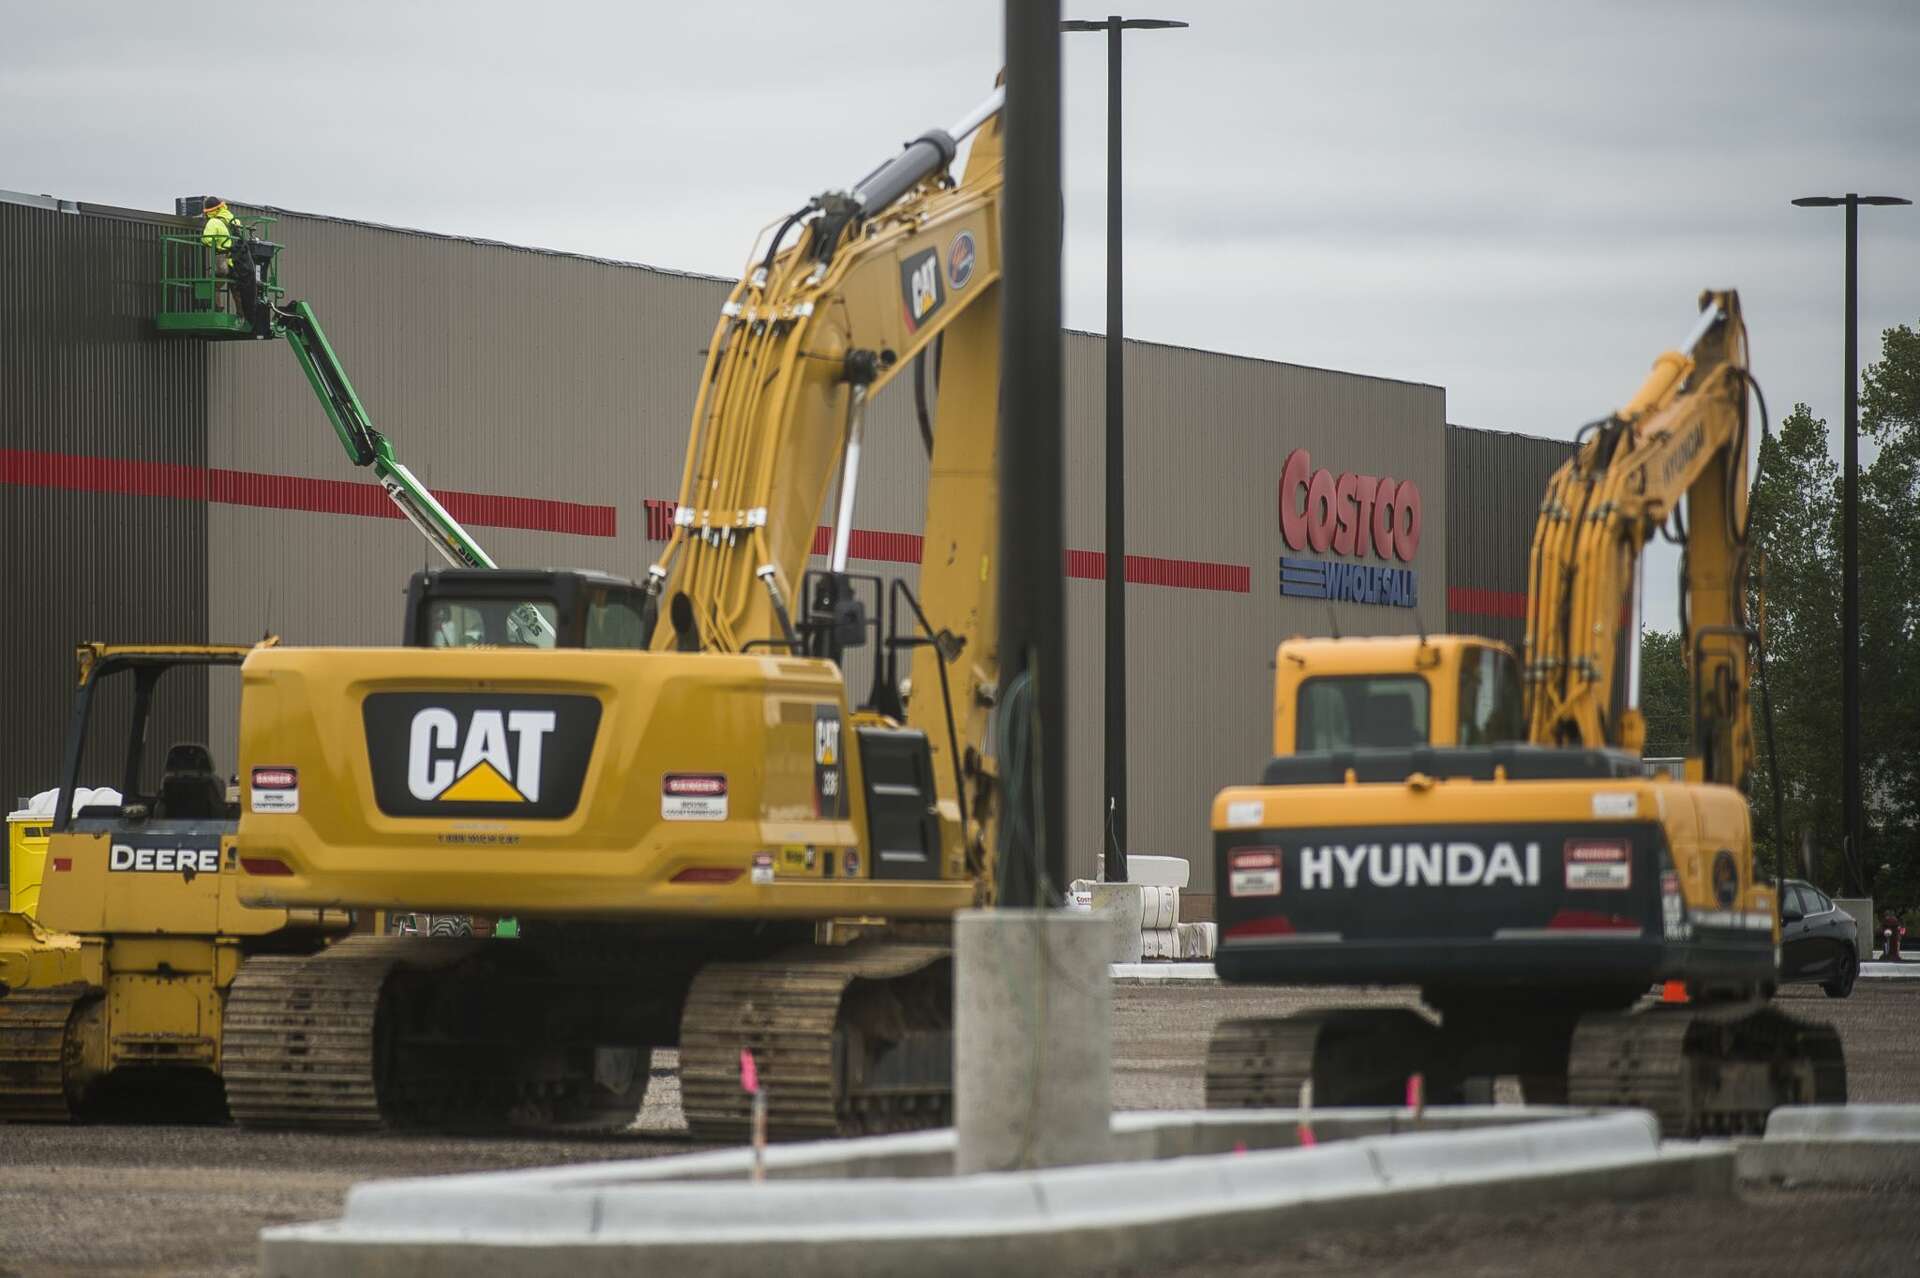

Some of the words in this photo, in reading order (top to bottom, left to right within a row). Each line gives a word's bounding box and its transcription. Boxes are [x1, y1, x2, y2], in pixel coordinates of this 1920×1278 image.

[911, 255, 937, 319] CAT
[643, 499, 675, 541] TIR
[1279, 448, 1421, 562] COSTCO
[408, 707, 556, 803] CAT
[110, 844, 218, 872] DEERE
[1300, 841, 1540, 889] HYUNDAI
